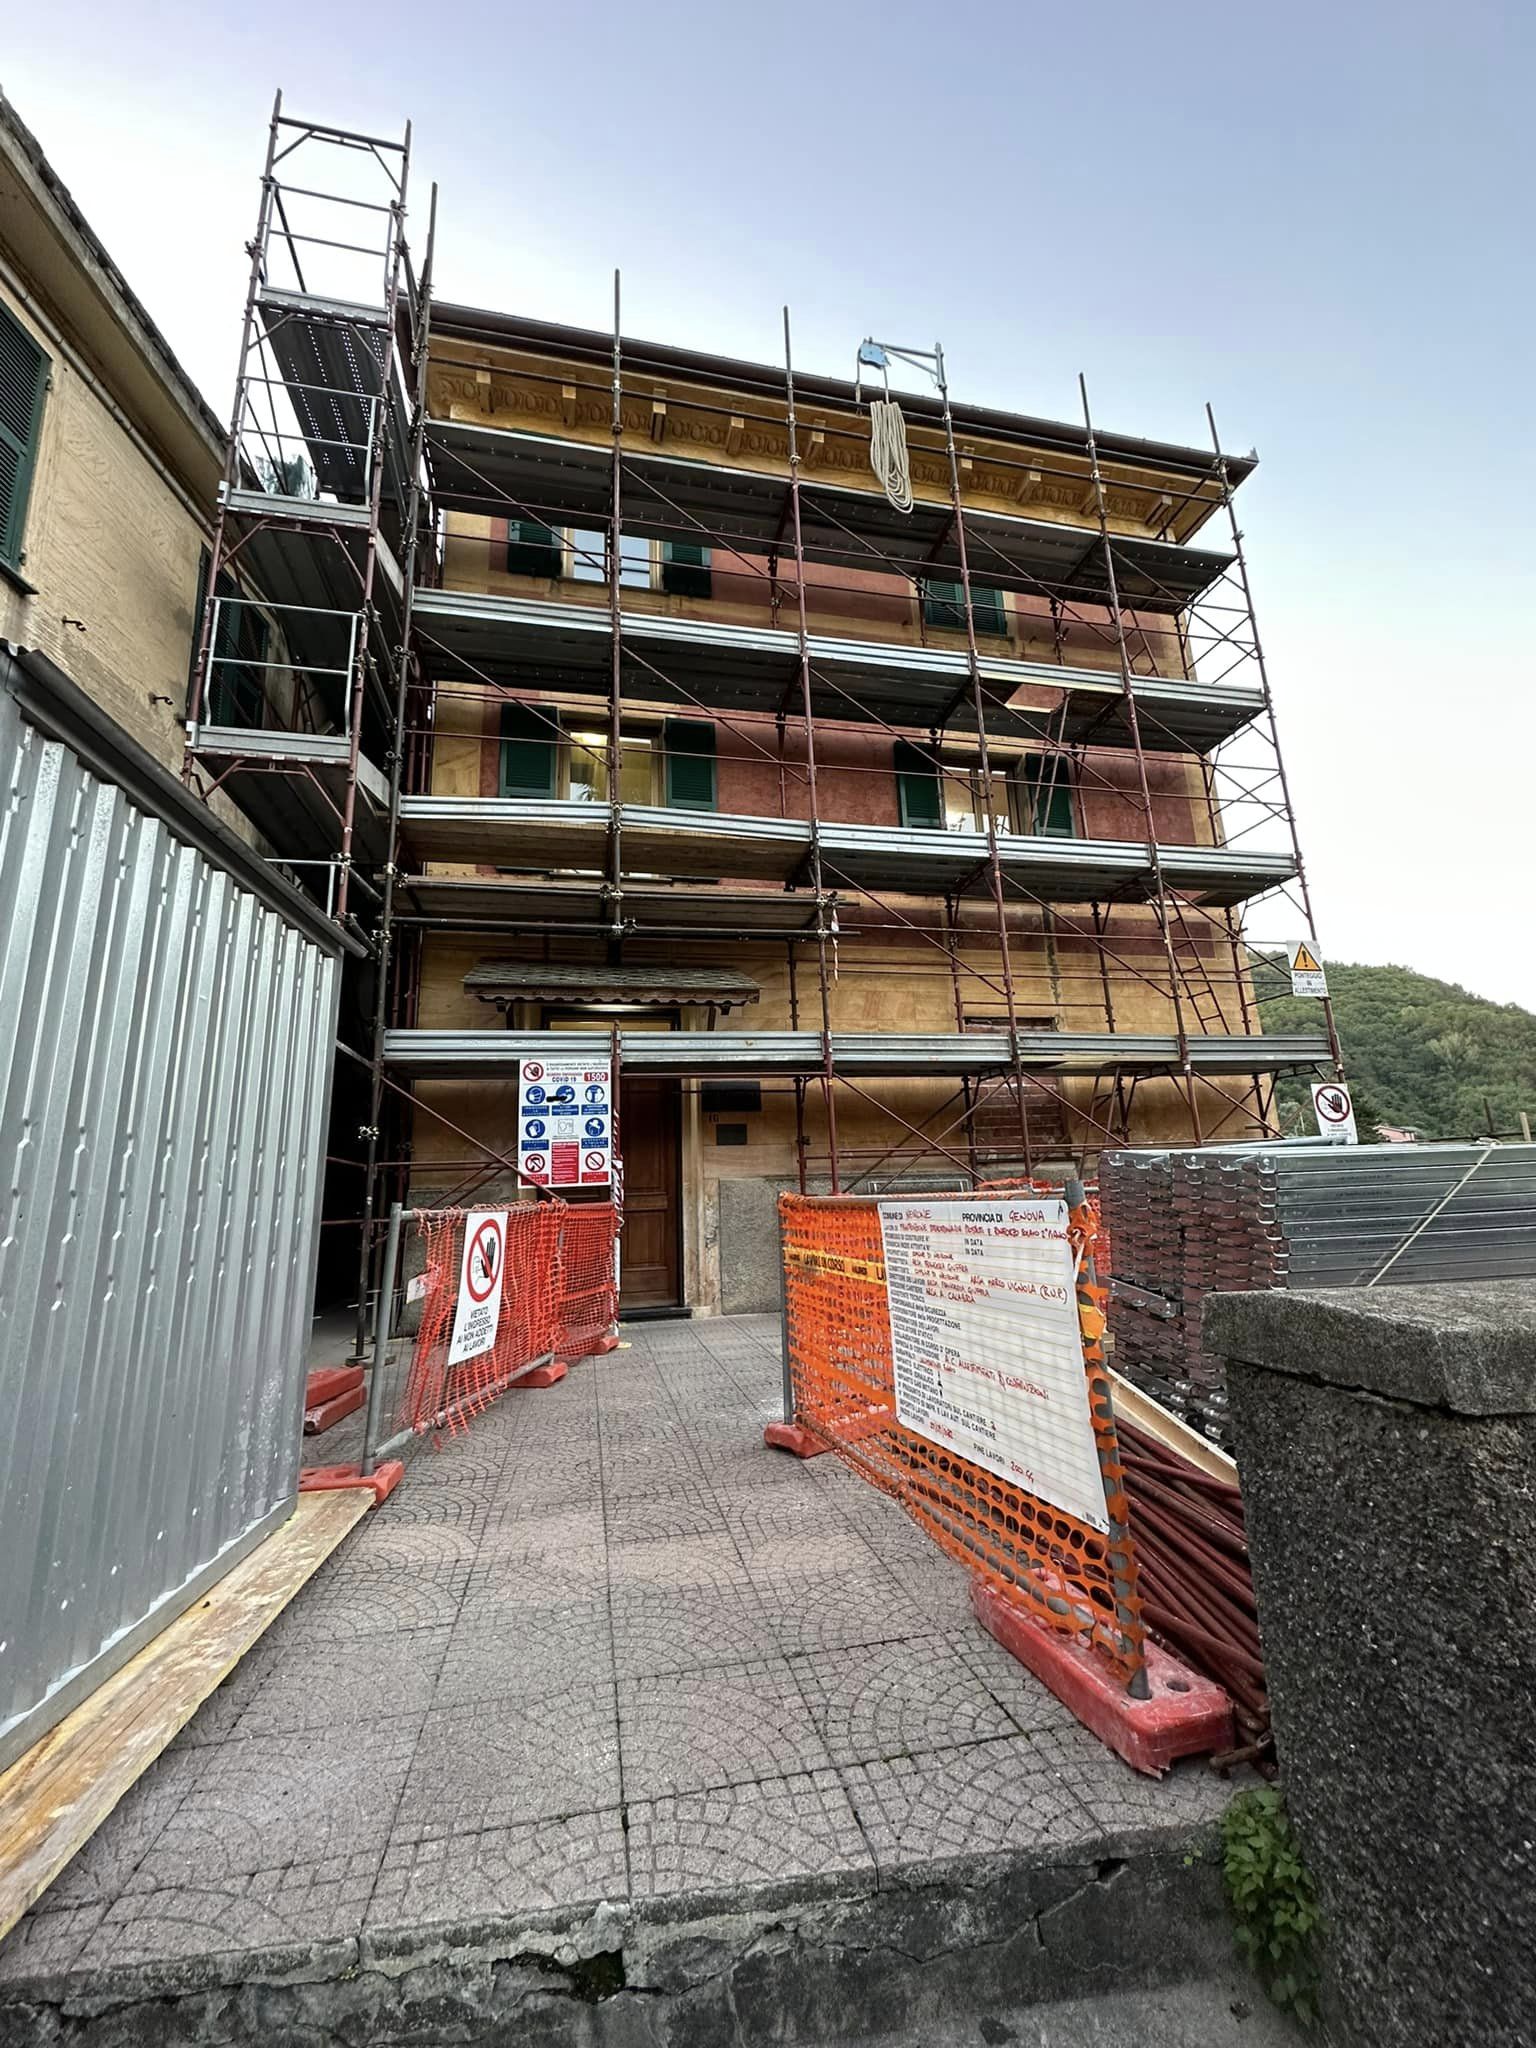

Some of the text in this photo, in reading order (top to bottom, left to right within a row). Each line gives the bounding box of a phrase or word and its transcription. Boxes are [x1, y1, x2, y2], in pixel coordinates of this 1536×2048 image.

[587, 1072, 606, 1081] 1500
[962, 1213, 1002, 1222] PROVINCIA DI
[1008, 1210, 1044, 1222] GENOVA
[470, 1305, 489, 1319] VIETATO
[463, 1315, 491, 1332] L'INGRESSO
[464, 1330, 475, 1342] NON
[475, 1323, 493, 1338] ADDETTI
[469, 1336, 486, 1351] LAVORI
